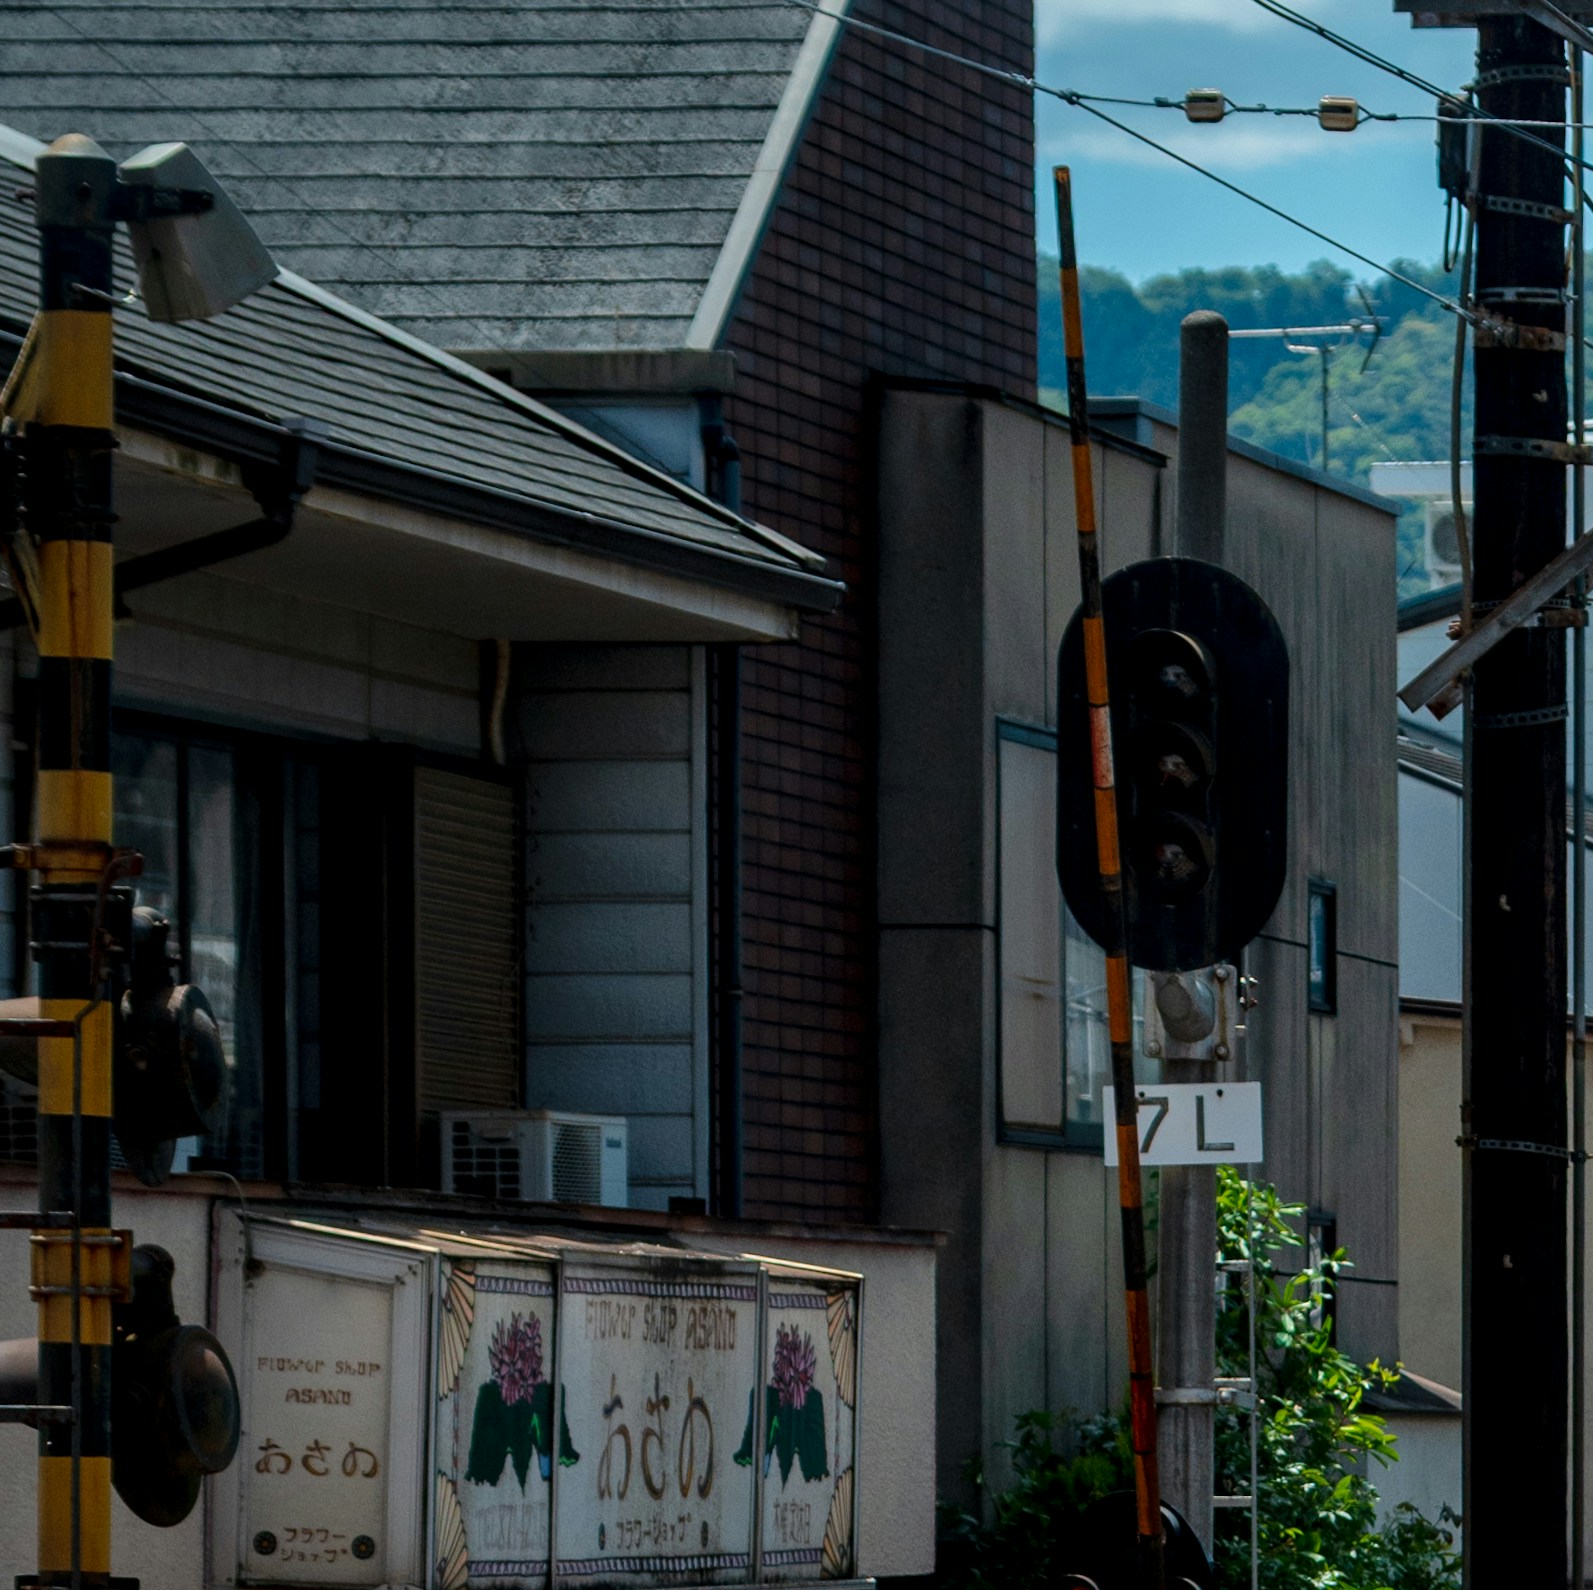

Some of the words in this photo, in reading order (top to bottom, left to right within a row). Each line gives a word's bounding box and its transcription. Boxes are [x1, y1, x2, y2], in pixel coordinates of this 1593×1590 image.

[1196, 1095, 1235, 1152] L
[684, 1306, 738, 1350] ASANO
[284, 1387, 354, 1406] ASANO
[597, 1371, 715, 1501] あさの
[254, 1437, 380, 1479] あさの
[280, 1547, 349, 1564] ショップ
[283, 1526, 348, 1543] フラワー
